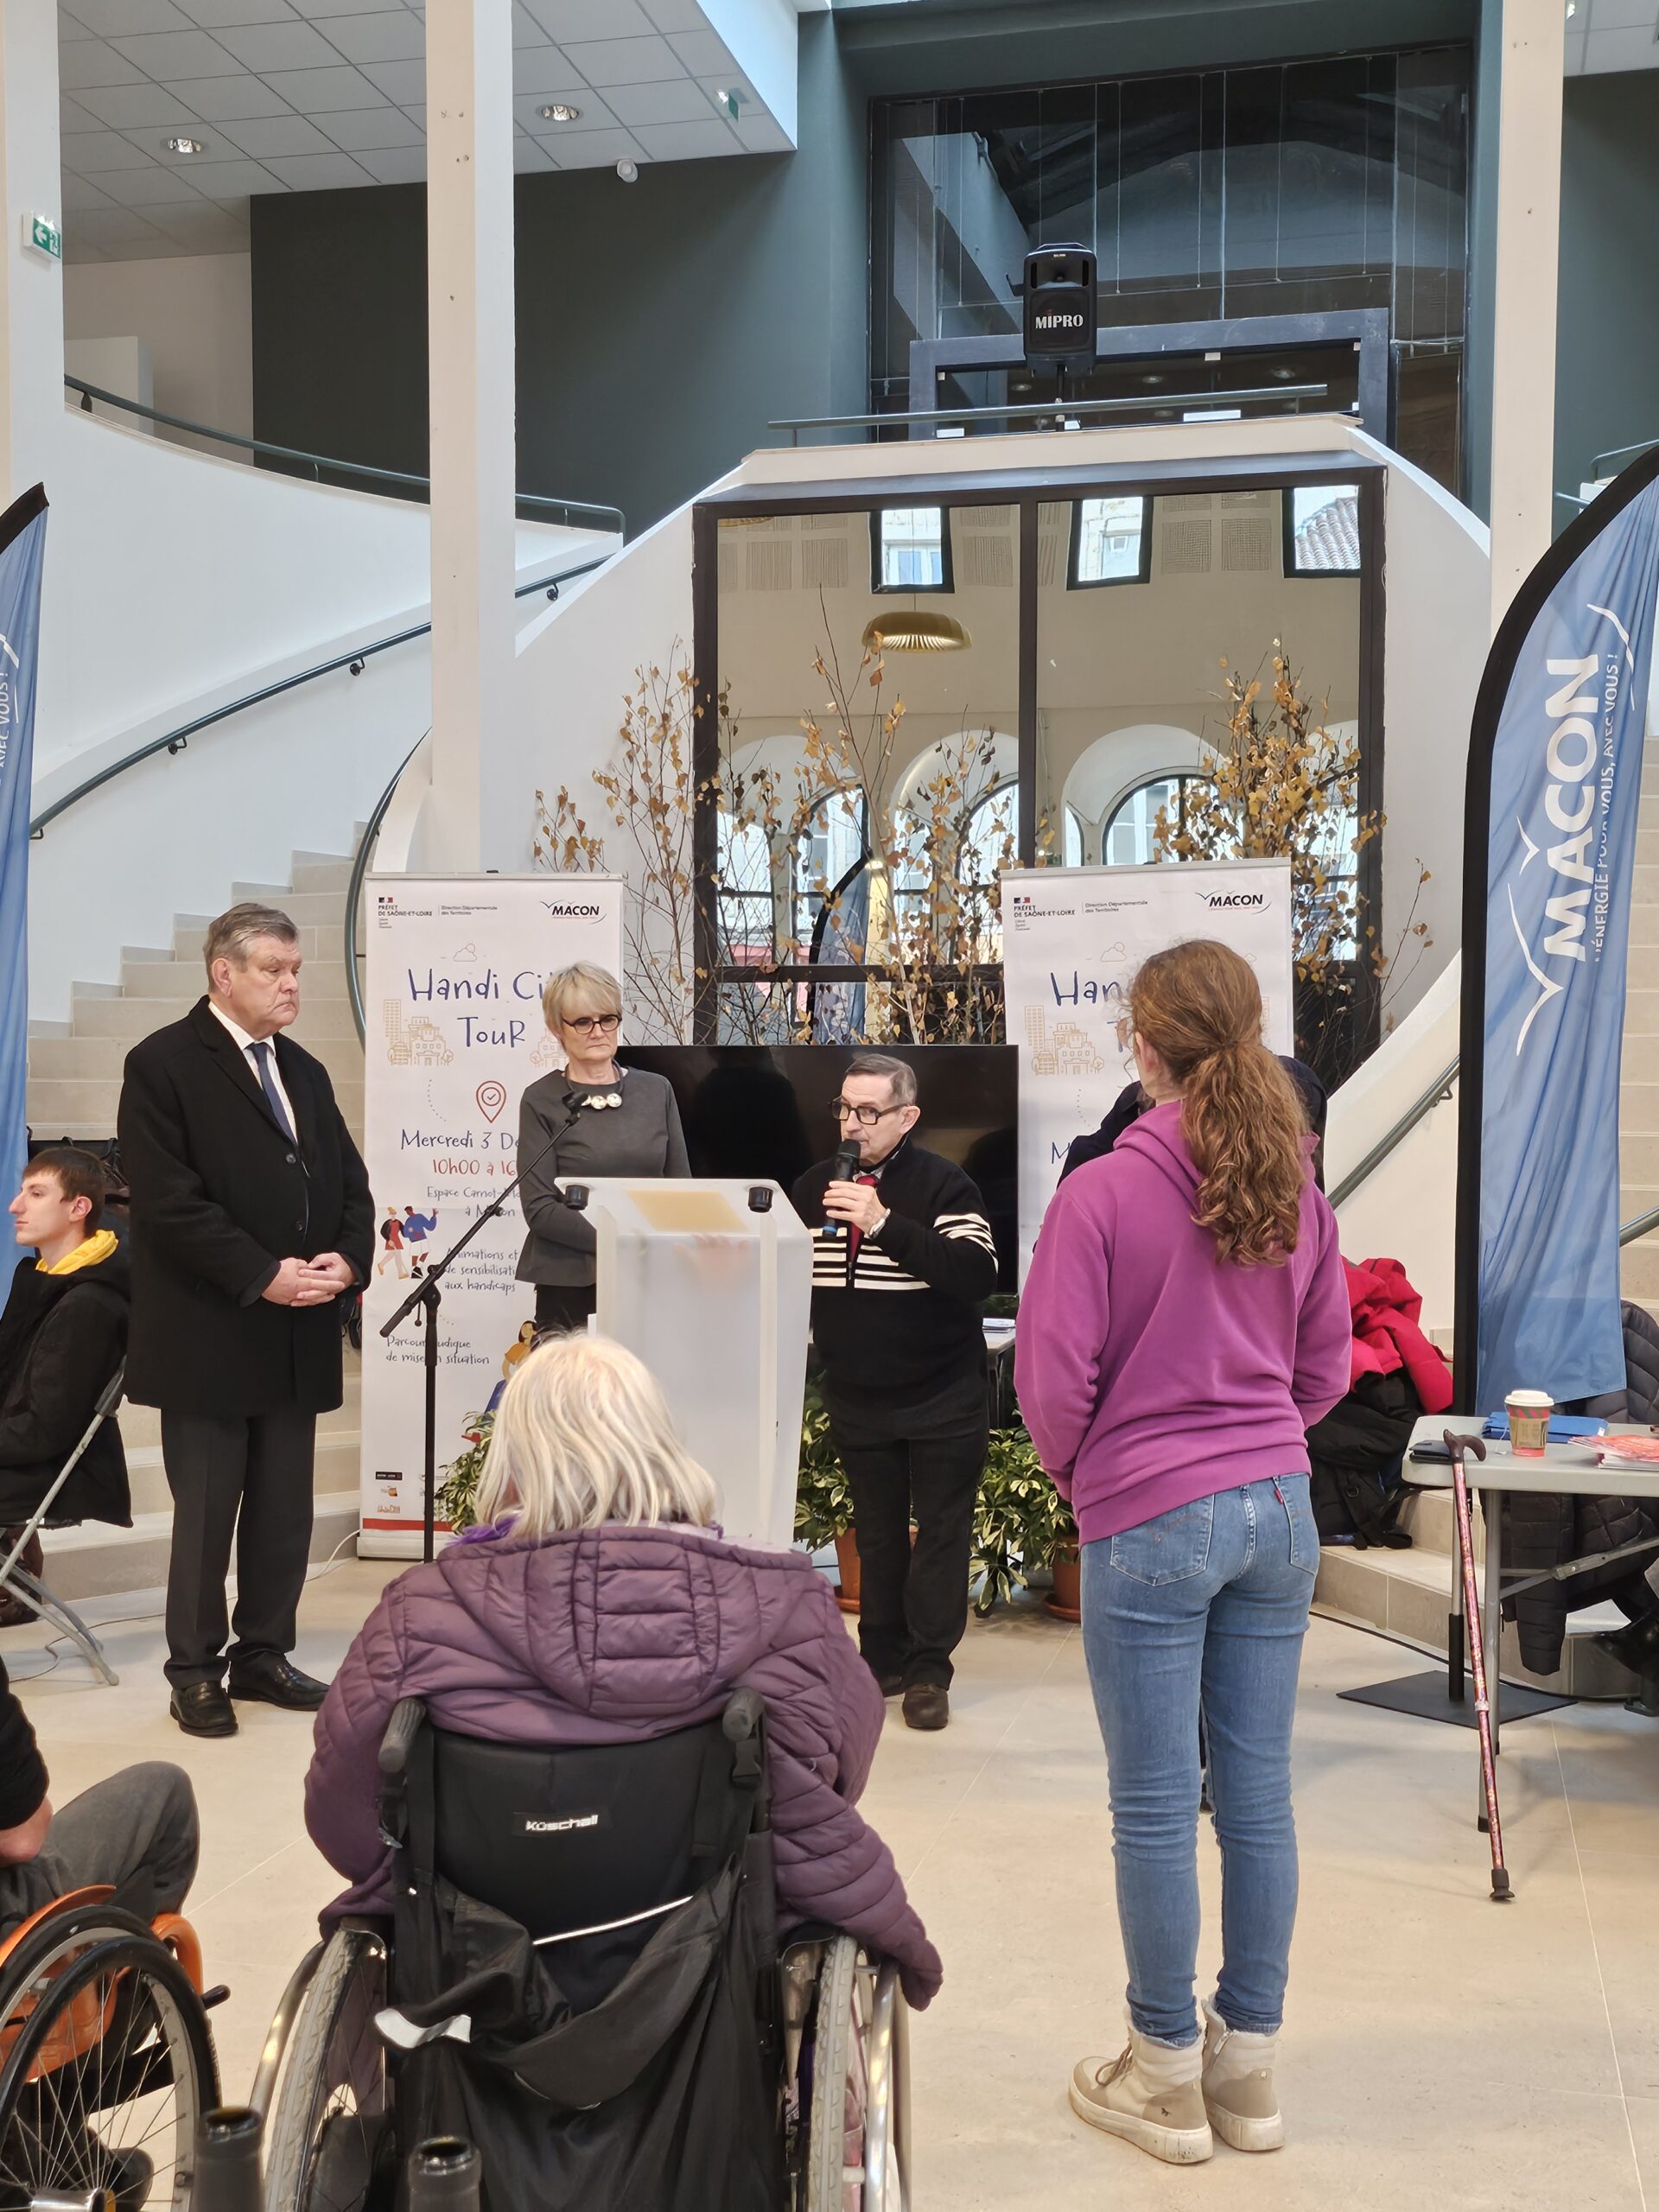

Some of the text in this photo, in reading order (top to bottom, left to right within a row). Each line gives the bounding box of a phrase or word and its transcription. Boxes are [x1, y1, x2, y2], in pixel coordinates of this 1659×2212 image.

[1035, 314, 1084, 329] MIPRO
[1605, 664, 1619, 712] VOUS
[1603, 715, 1614, 757] AVEC
[408, 969, 553, 1001] Handi Ci
[401, 1128, 474, 1150] Mercredi
[480, 1131, 493, 1149] 3
[433, 1158, 480, 1175] 10h00
[486, 1161, 494, 1176] à
[427, 1186, 459, 1201] Espace
[508, 1249, 518, 1261] et
[444, 1279, 516, 1296] aux handicaps
[386, 1351, 397, 1362] de
[446, 1352, 490, 1364] situation
